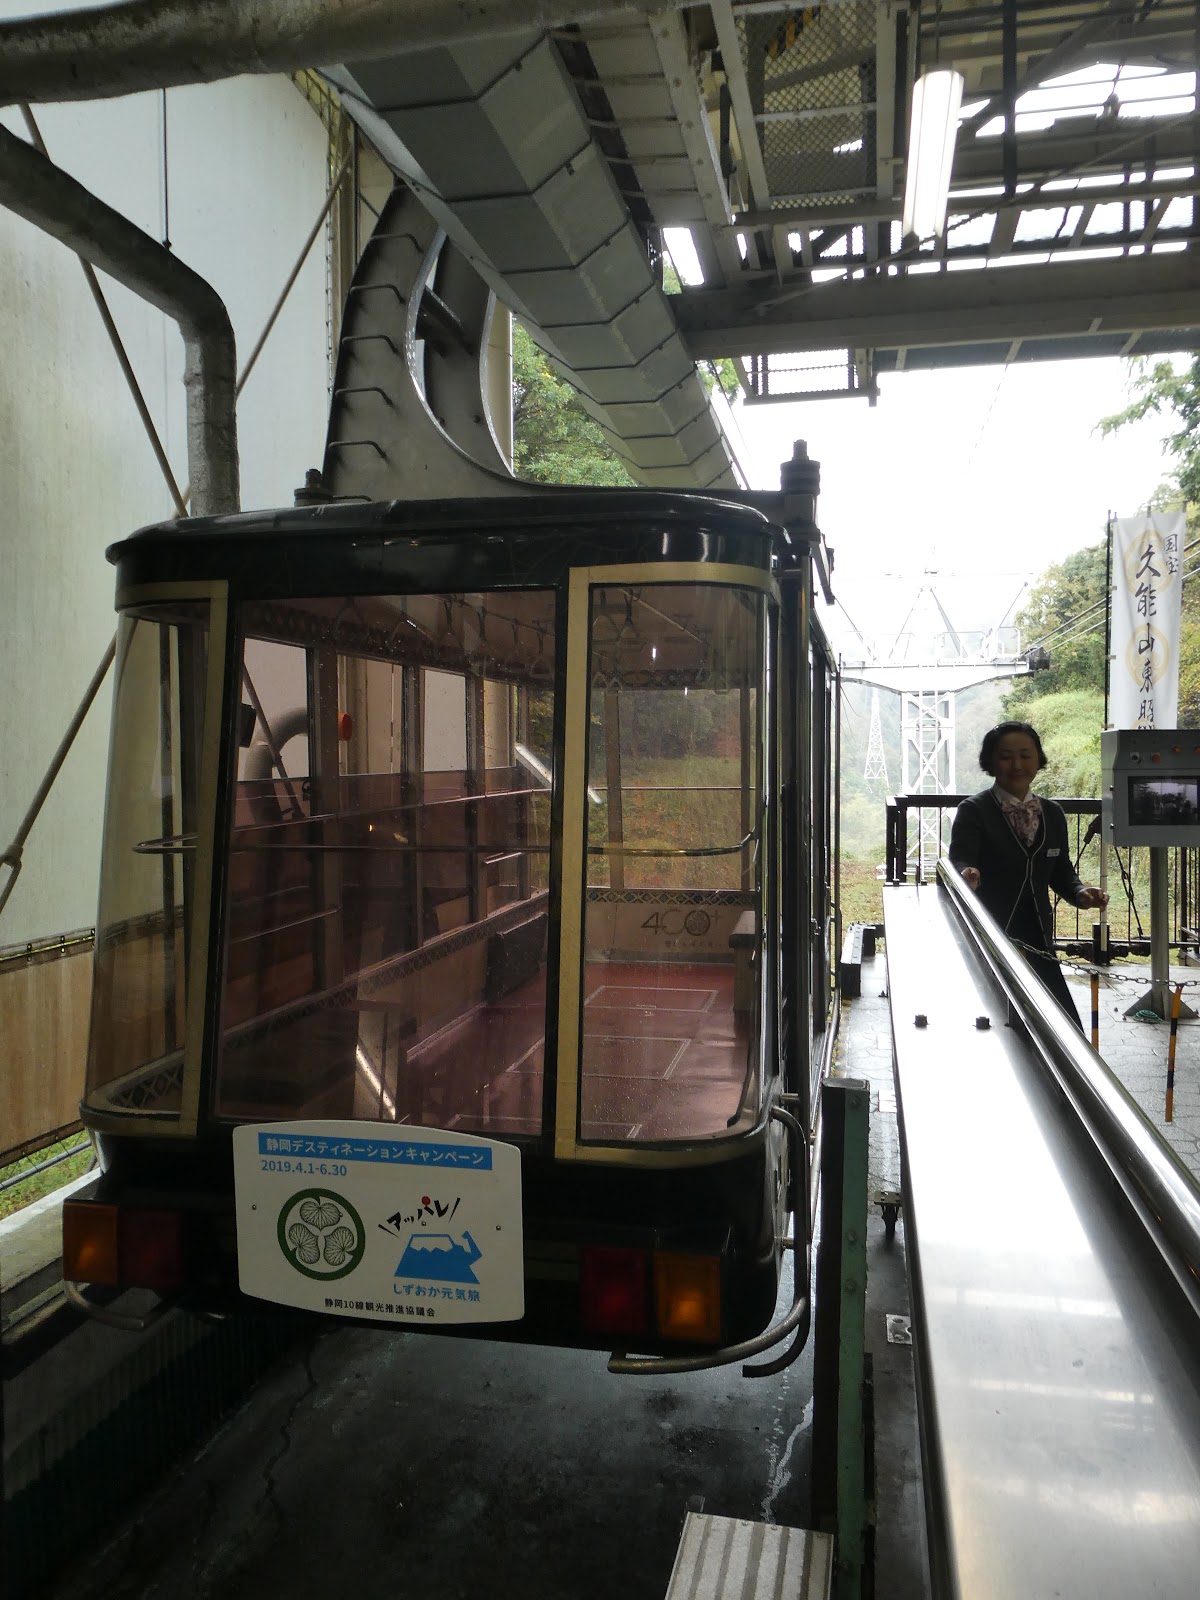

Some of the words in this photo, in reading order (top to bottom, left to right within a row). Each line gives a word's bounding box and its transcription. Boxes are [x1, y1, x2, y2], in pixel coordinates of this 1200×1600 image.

[1164, 533, 1179, 575] 国宝
[265, 1137, 485, 1165] 静岡デスティネーションキャンペーン
[261, 1159, 348, 1177] 2019.4.1-6.30
[392, 1283, 482, 1302] しずおか元気旅
[324, 1297, 436, 1317] 静岡10線観光推進協議会
